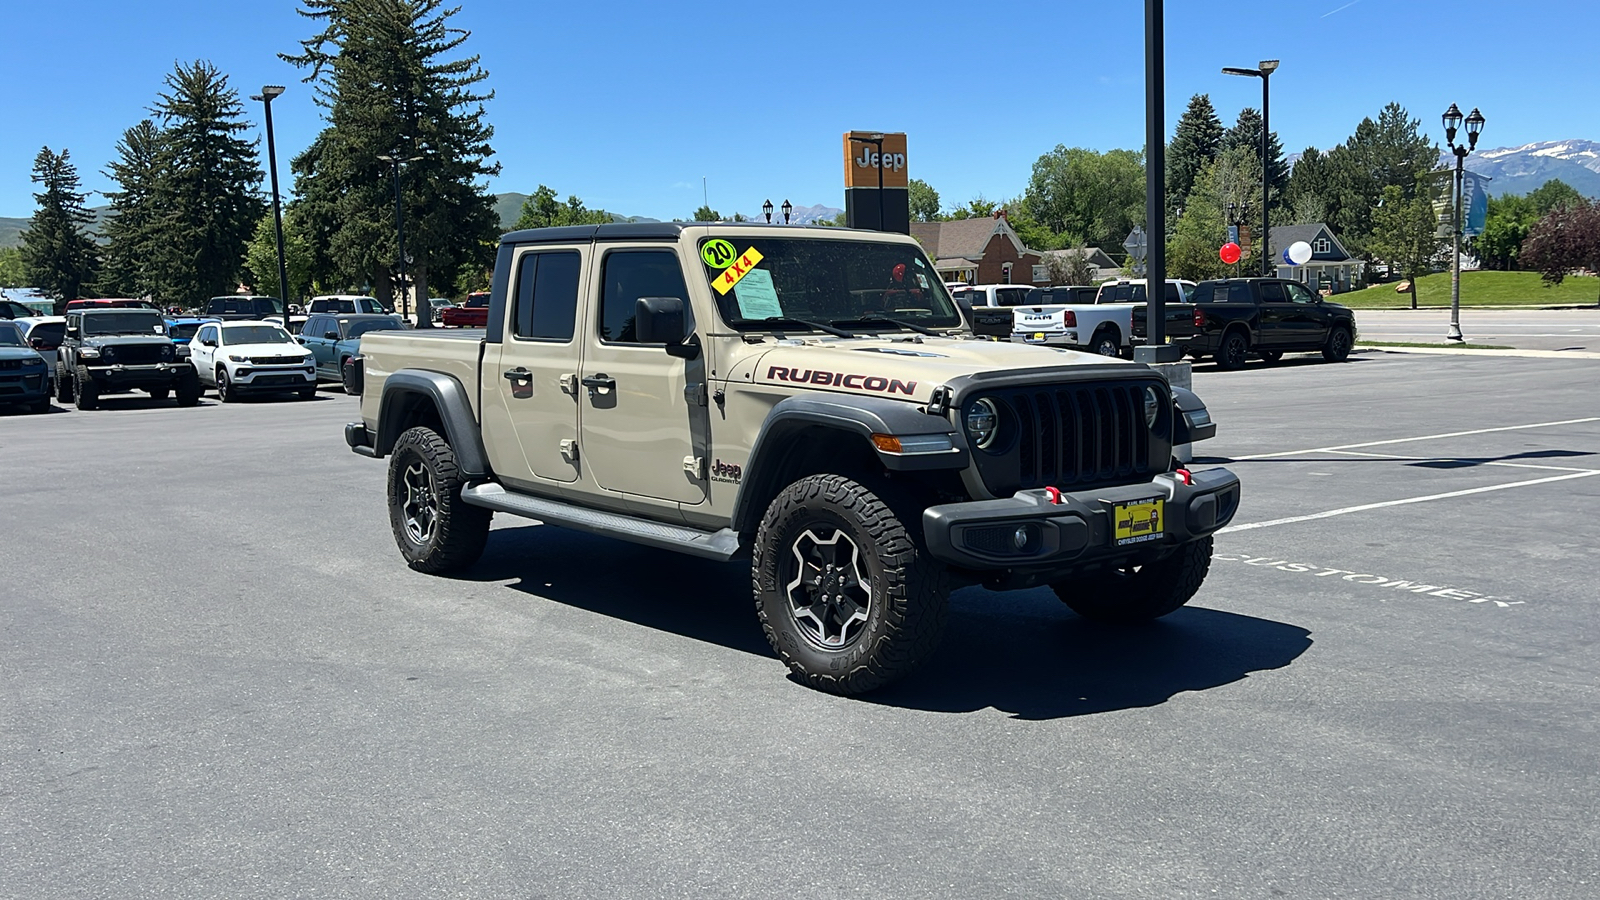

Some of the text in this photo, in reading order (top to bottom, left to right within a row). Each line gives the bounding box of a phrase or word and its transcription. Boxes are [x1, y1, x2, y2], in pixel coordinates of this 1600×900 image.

[856, 147, 905, 173] Jeep
[706, 241, 732, 266] 20
[766, 365, 918, 396] RUBICON
[711, 458, 742, 481] Jeep
